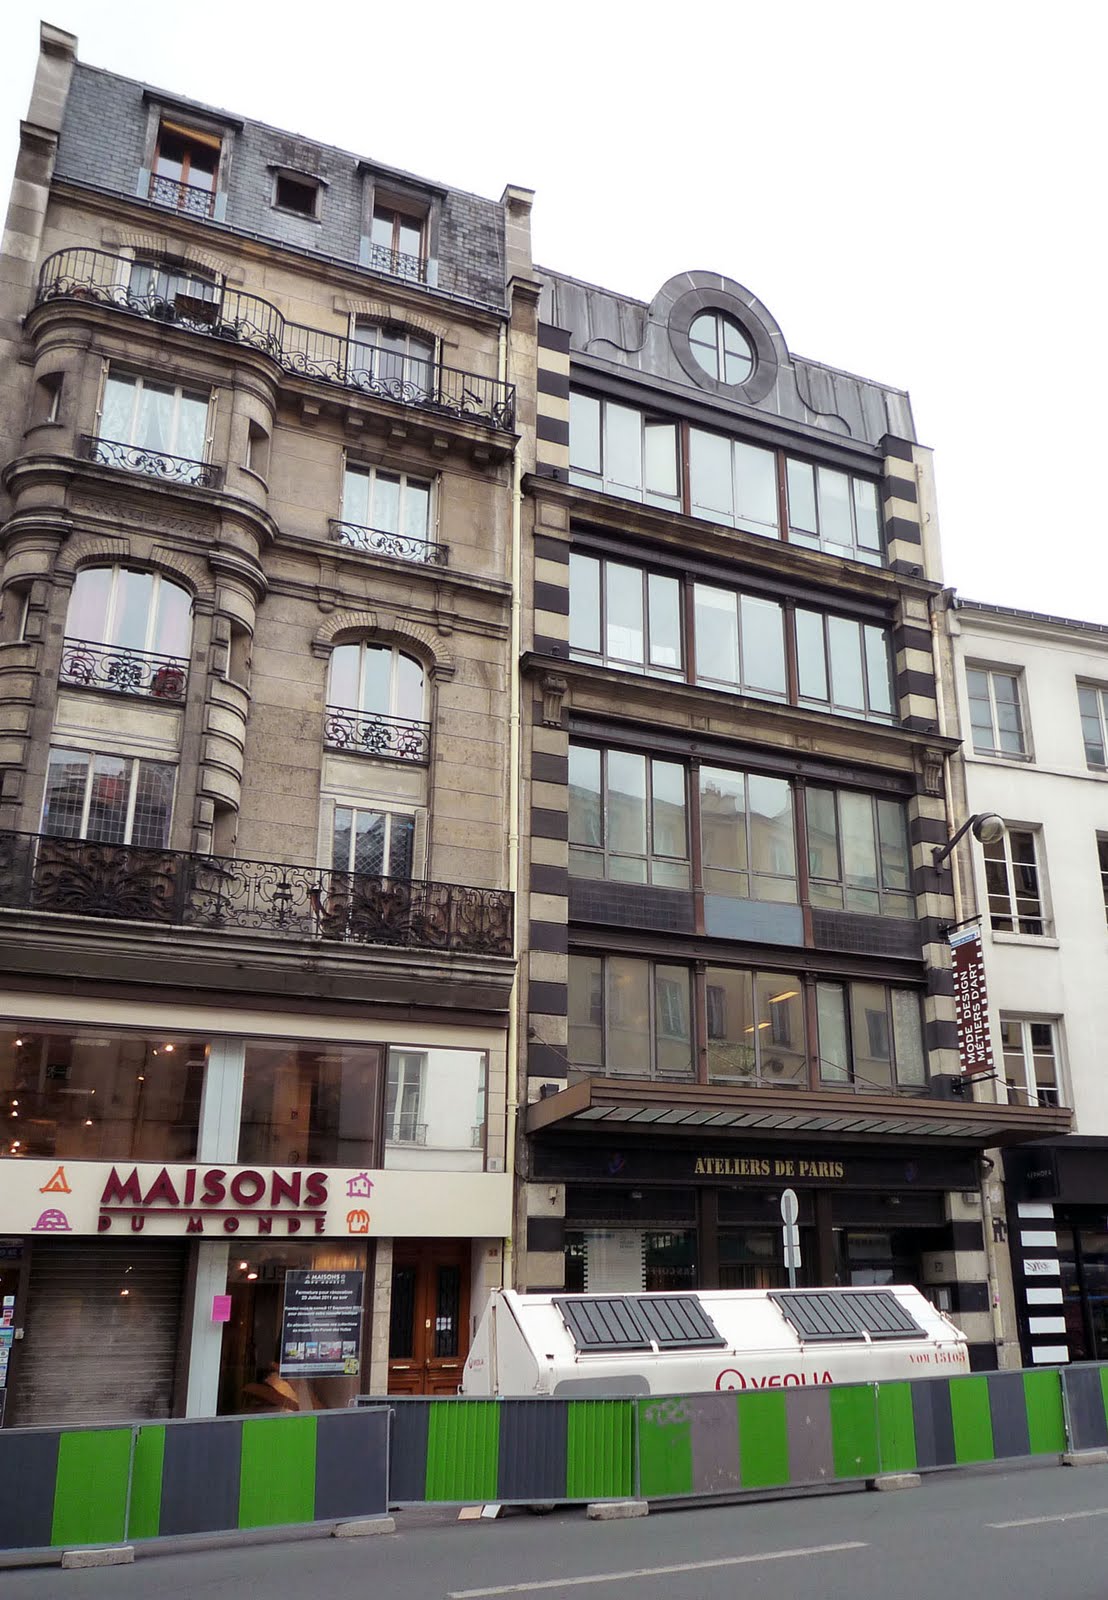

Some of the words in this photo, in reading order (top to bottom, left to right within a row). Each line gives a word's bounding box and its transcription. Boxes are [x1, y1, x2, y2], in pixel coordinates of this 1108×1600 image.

[960, 971, 971, 1019] DESIGN
[968, 963, 980, 1000] D'ART
[964, 1025, 976, 1064] MODE
[973, 1003, 986, 1062] MÉTIERS
[100, 1166, 329, 1207] MAISONS
[694, 1157, 770, 1176] ATELIERS
[775, 1160, 795, 1176] DE
[799, 1160, 844, 1178] PARIS
[98, 1215, 146, 1232] DU
[186, 1216, 327, 1235] MONDE
